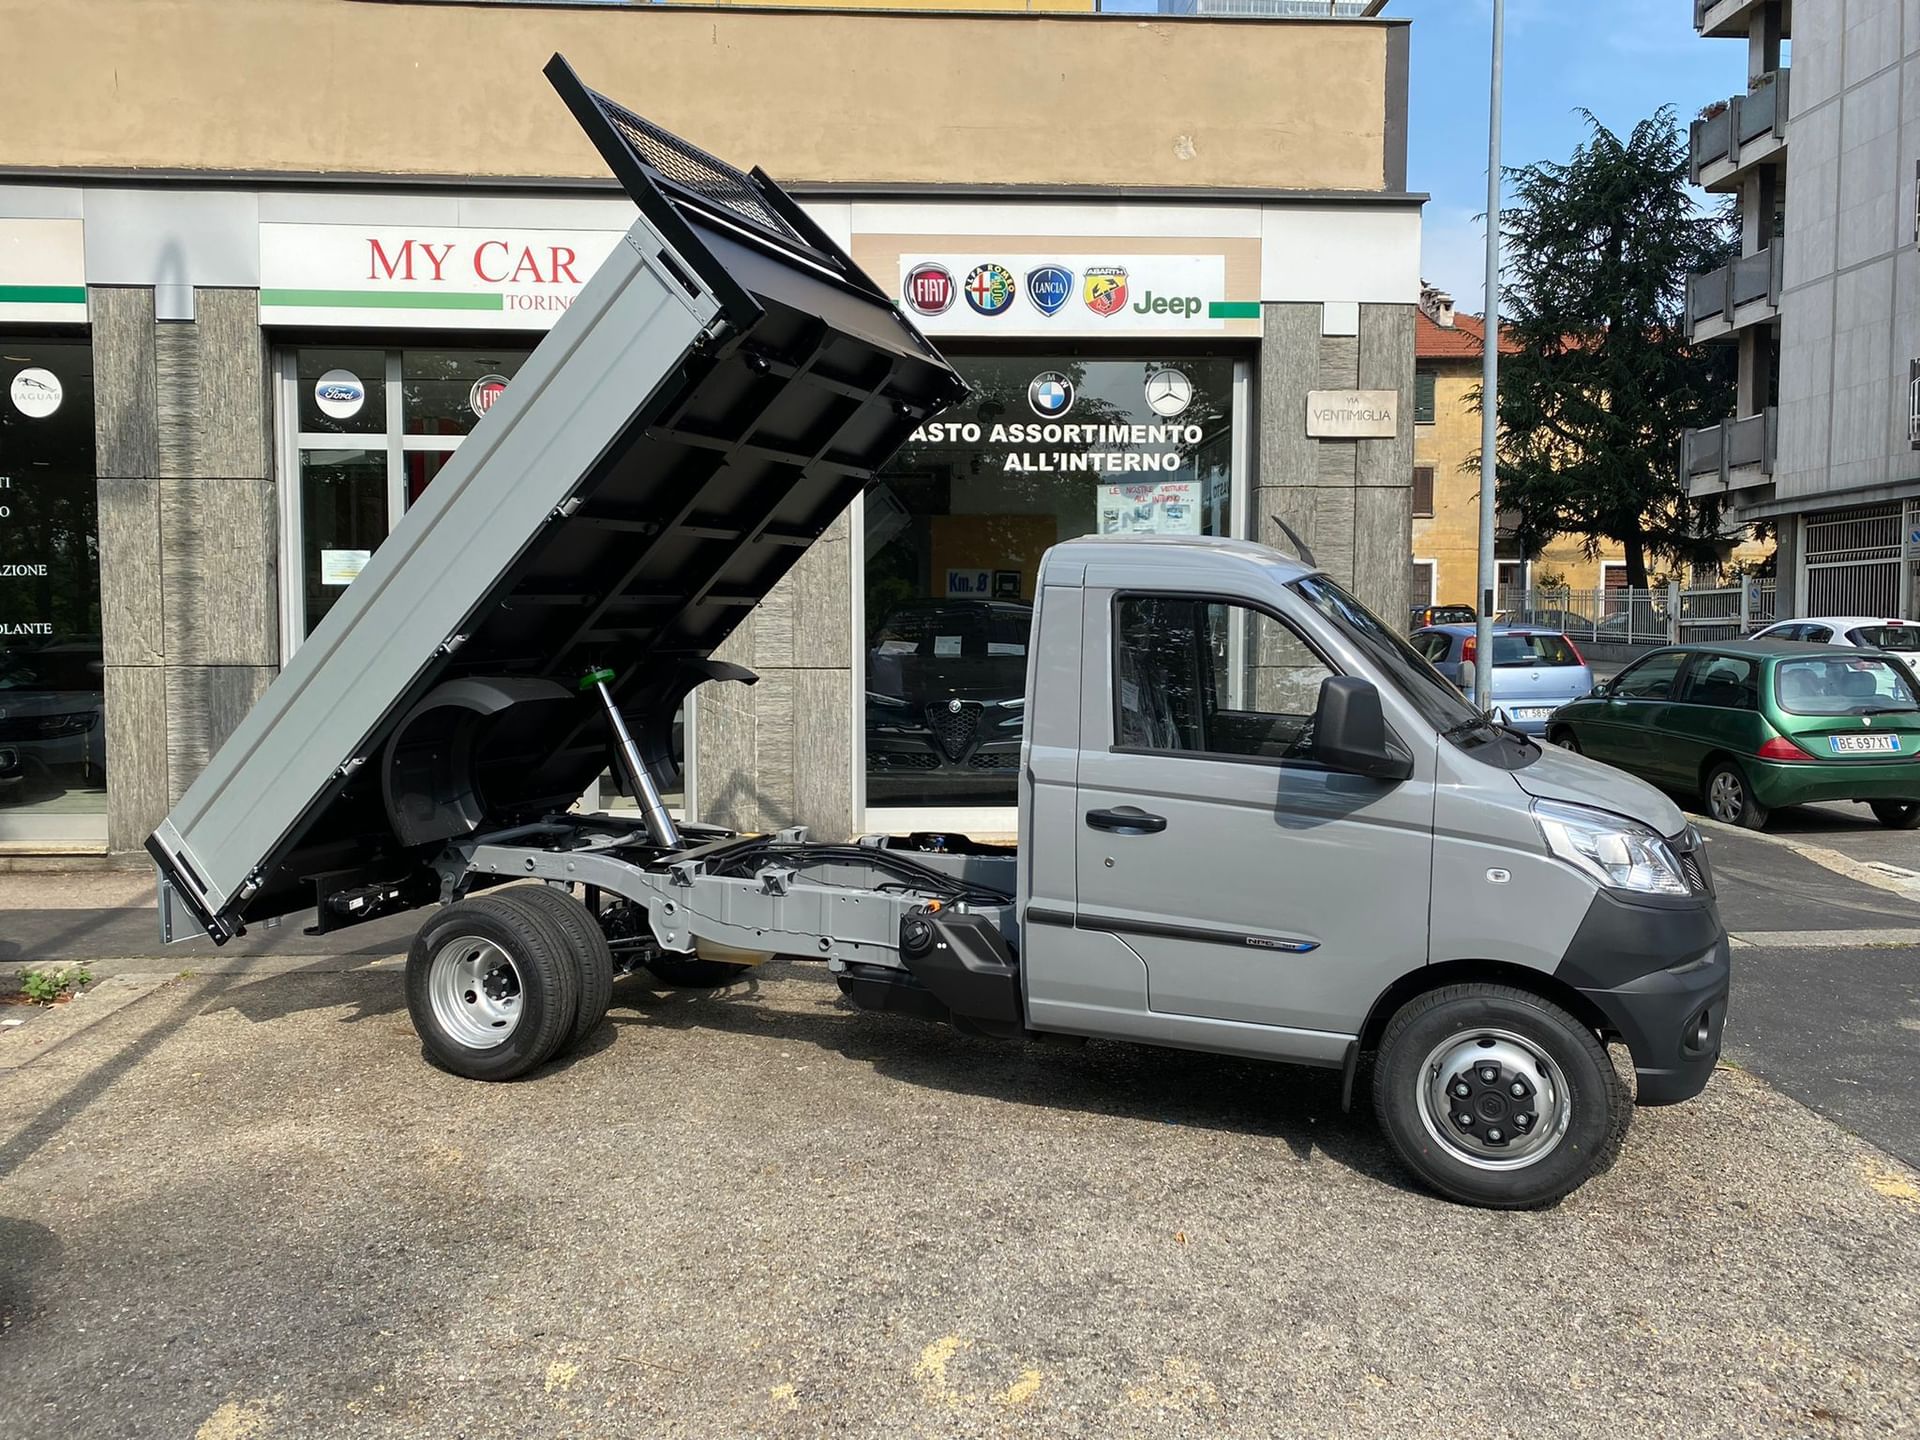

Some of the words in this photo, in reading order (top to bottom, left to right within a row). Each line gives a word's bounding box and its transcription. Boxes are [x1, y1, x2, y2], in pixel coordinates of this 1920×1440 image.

[366, 238, 456, 281] MY
[473, 240, 583, 284] CAR
[1087, 268, 1124, 276] ABARTH
[917, 278, 946, 303] FIAT
[1035, 281, 1064, 295] LANCIA
[1133, 290, 1202, 319] Jeep
[1033, 374, 1070, 388] BMW
[14, 393, 61, 401] JAGUAR
[325, 387, 354, 400] Ford
[483, 389, 503, 409] FI
[1346, 397, 1360, 405] VIA
[1313, 409, 1392, 423] VENTIMIGLIA
[989, 424, 1204, 444] ASSORTIMENTO
[1839, 737, 1854, 750] BE
[1856, 735, 1891, 750] 697XT
